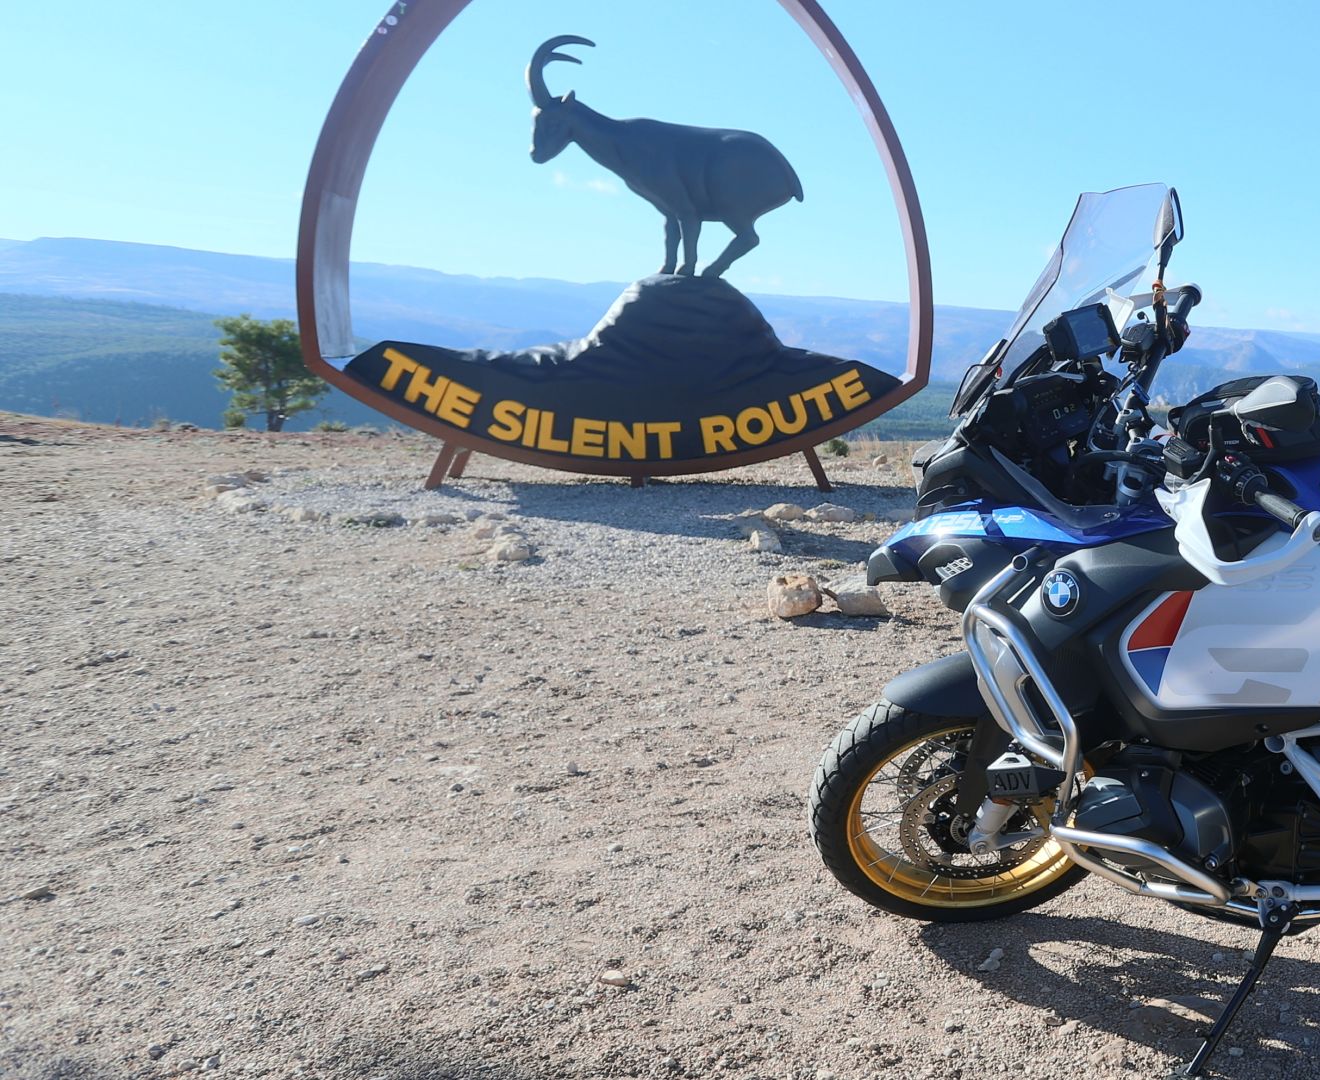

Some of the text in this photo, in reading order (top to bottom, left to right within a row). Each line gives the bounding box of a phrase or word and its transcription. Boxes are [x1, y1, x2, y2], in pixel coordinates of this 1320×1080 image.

[381, 348, 871, 460] THE SILENT ROUTE
[1046, 574, 1075, 589] BMW
[993, 772, 1031, 791] ADV
